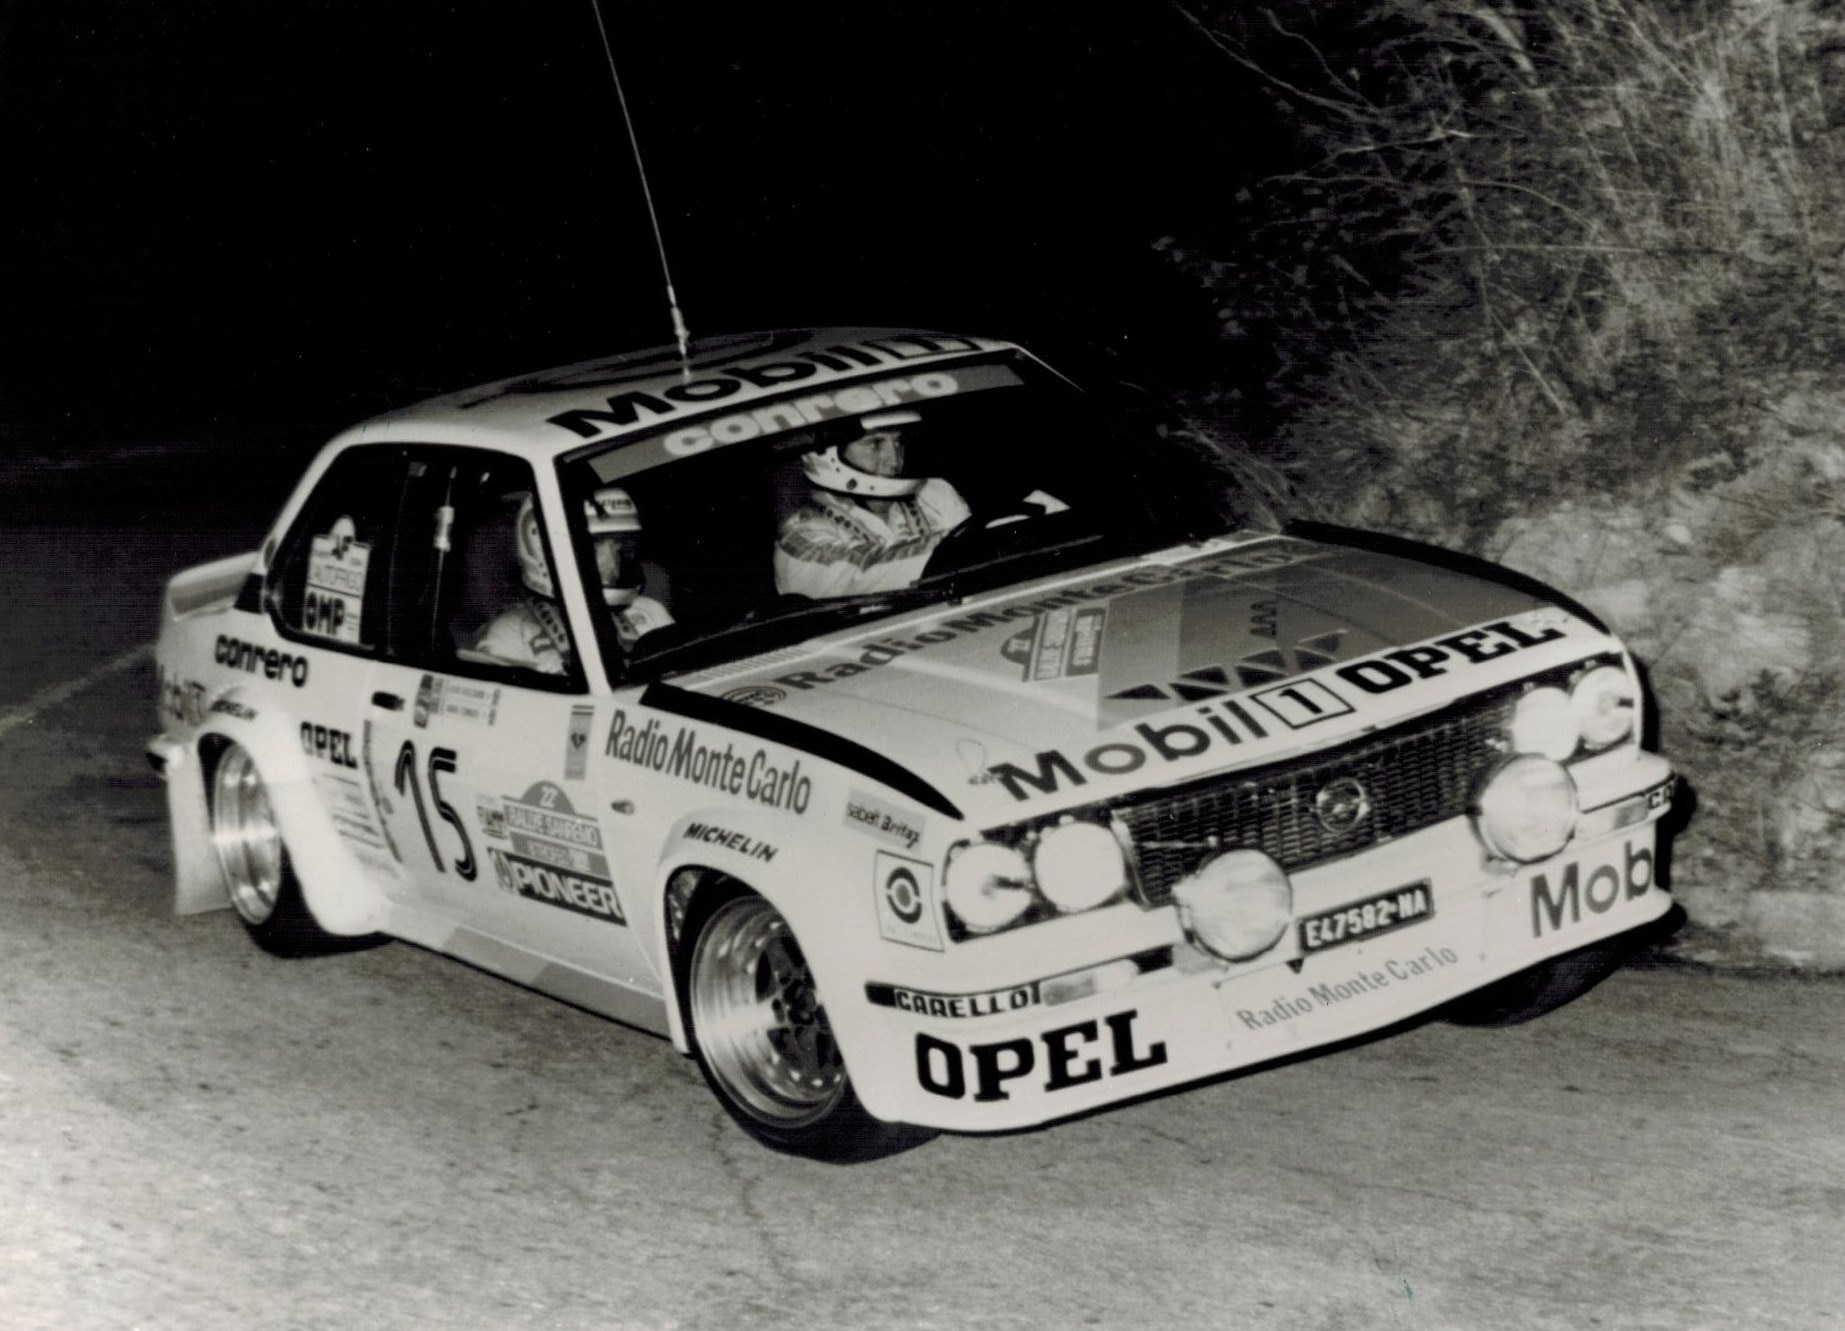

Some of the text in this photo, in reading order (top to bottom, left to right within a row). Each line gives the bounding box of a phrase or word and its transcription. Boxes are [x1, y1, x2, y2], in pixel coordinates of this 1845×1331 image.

[546, 345, 883, 438] Mobil
[663, 372, 959, 456] conrero
[214, 634, 309, 688] conrero
[771, 629, 958, 690] Radio
[942, 583, 1136, 632] Monte
[1335, 620, 1567, 694] OPEL
[300, 721, 358, 769] OPEL
[605, 709, 812, 815] Radio Monte Carlo
[987, 700, 1269, 801] Mobil
[394, 739, 478, 882] 15
[683, 822, 778, 863] MICHELIN
[512, 862, 624, 919] PIONEER
[896, 988, 1029, 1018] CARELLO
[1236, 947, 1459, 1030] Radio Monte Carlo
[915, 1008, 1168, 1101] OPEL
